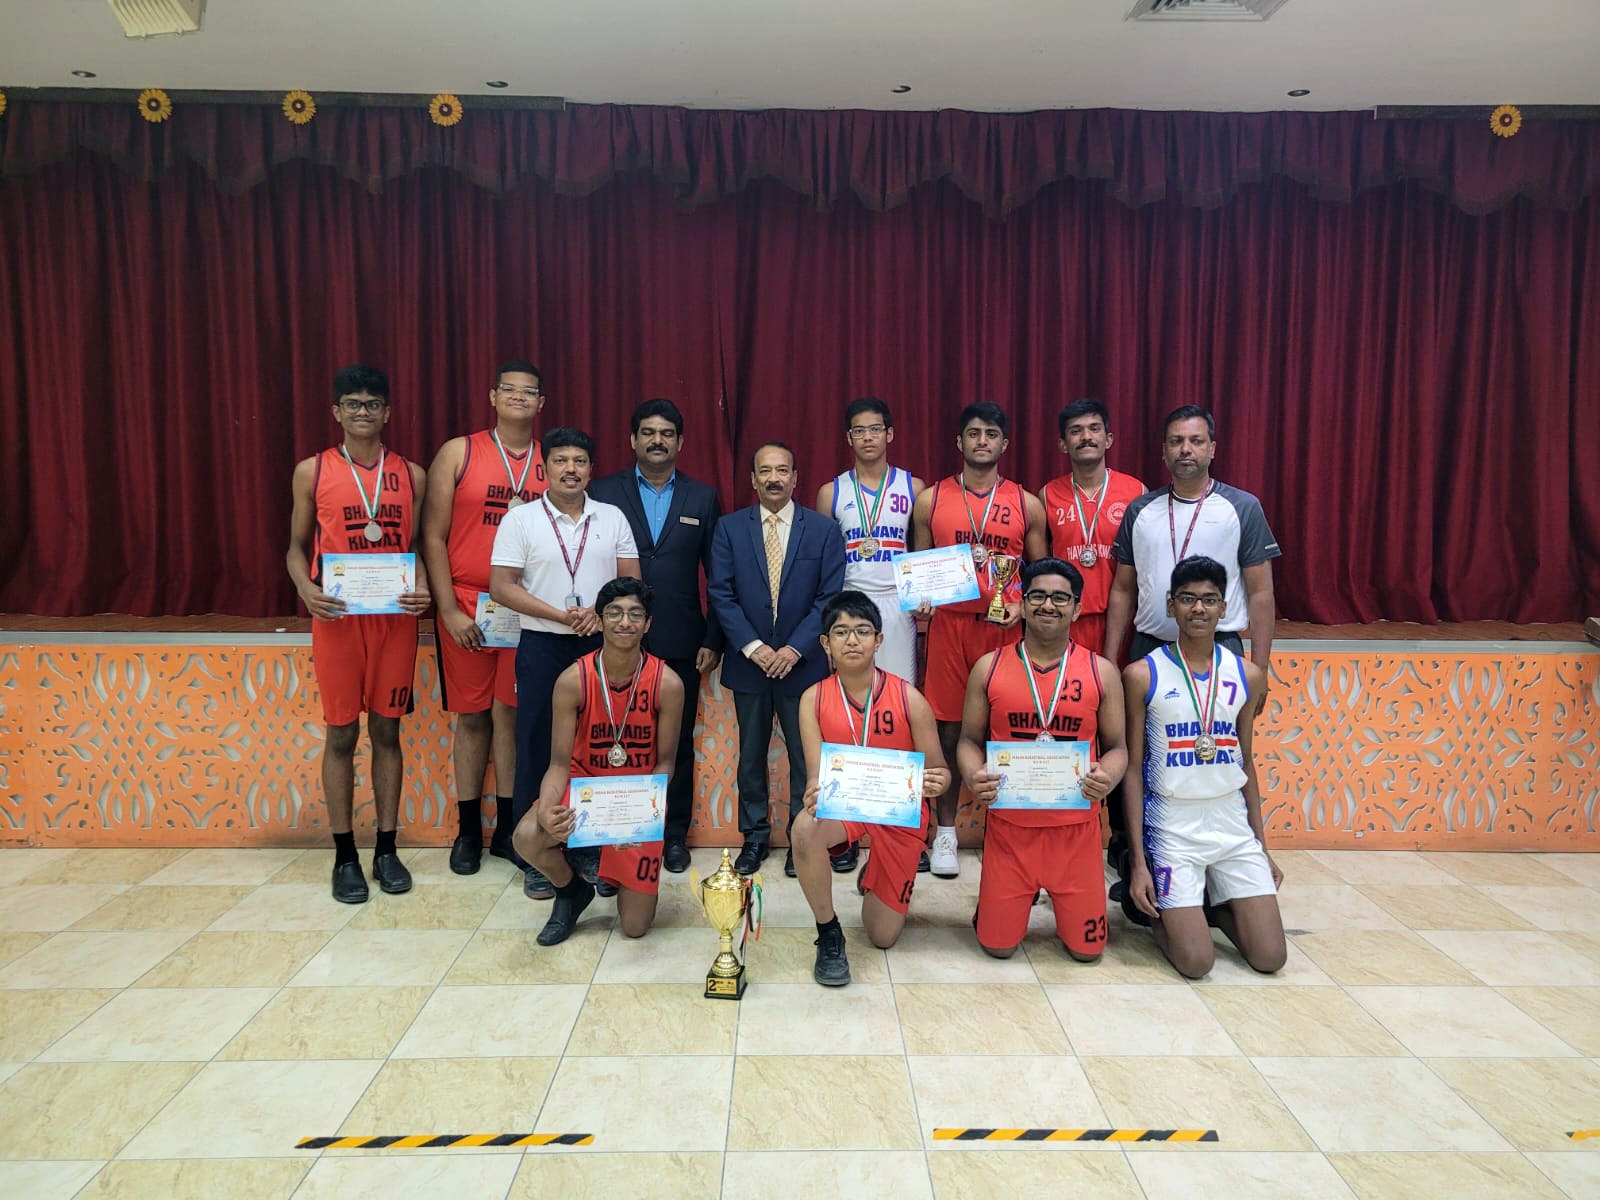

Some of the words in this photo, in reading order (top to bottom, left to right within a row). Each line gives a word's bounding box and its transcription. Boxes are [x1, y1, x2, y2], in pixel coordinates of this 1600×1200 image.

[382, 472, 399, 492] 10
[890, 493, 909, 515] 30
[991, 503, 1011, 526] 72
[1056, 503, 1077, 526] 24
[389, 686, 408, 708] 10
[627, 689, 649, 712] 03
[1060, 679, 1082, 702] 23
[1222, 680, 1238, 706] 7
[874, 709, 894, 735] 19
[636, 855, 660, 883] 03
[1154, 866, 1172, 897] 7
[1084, 914, 1106, 943] 23
